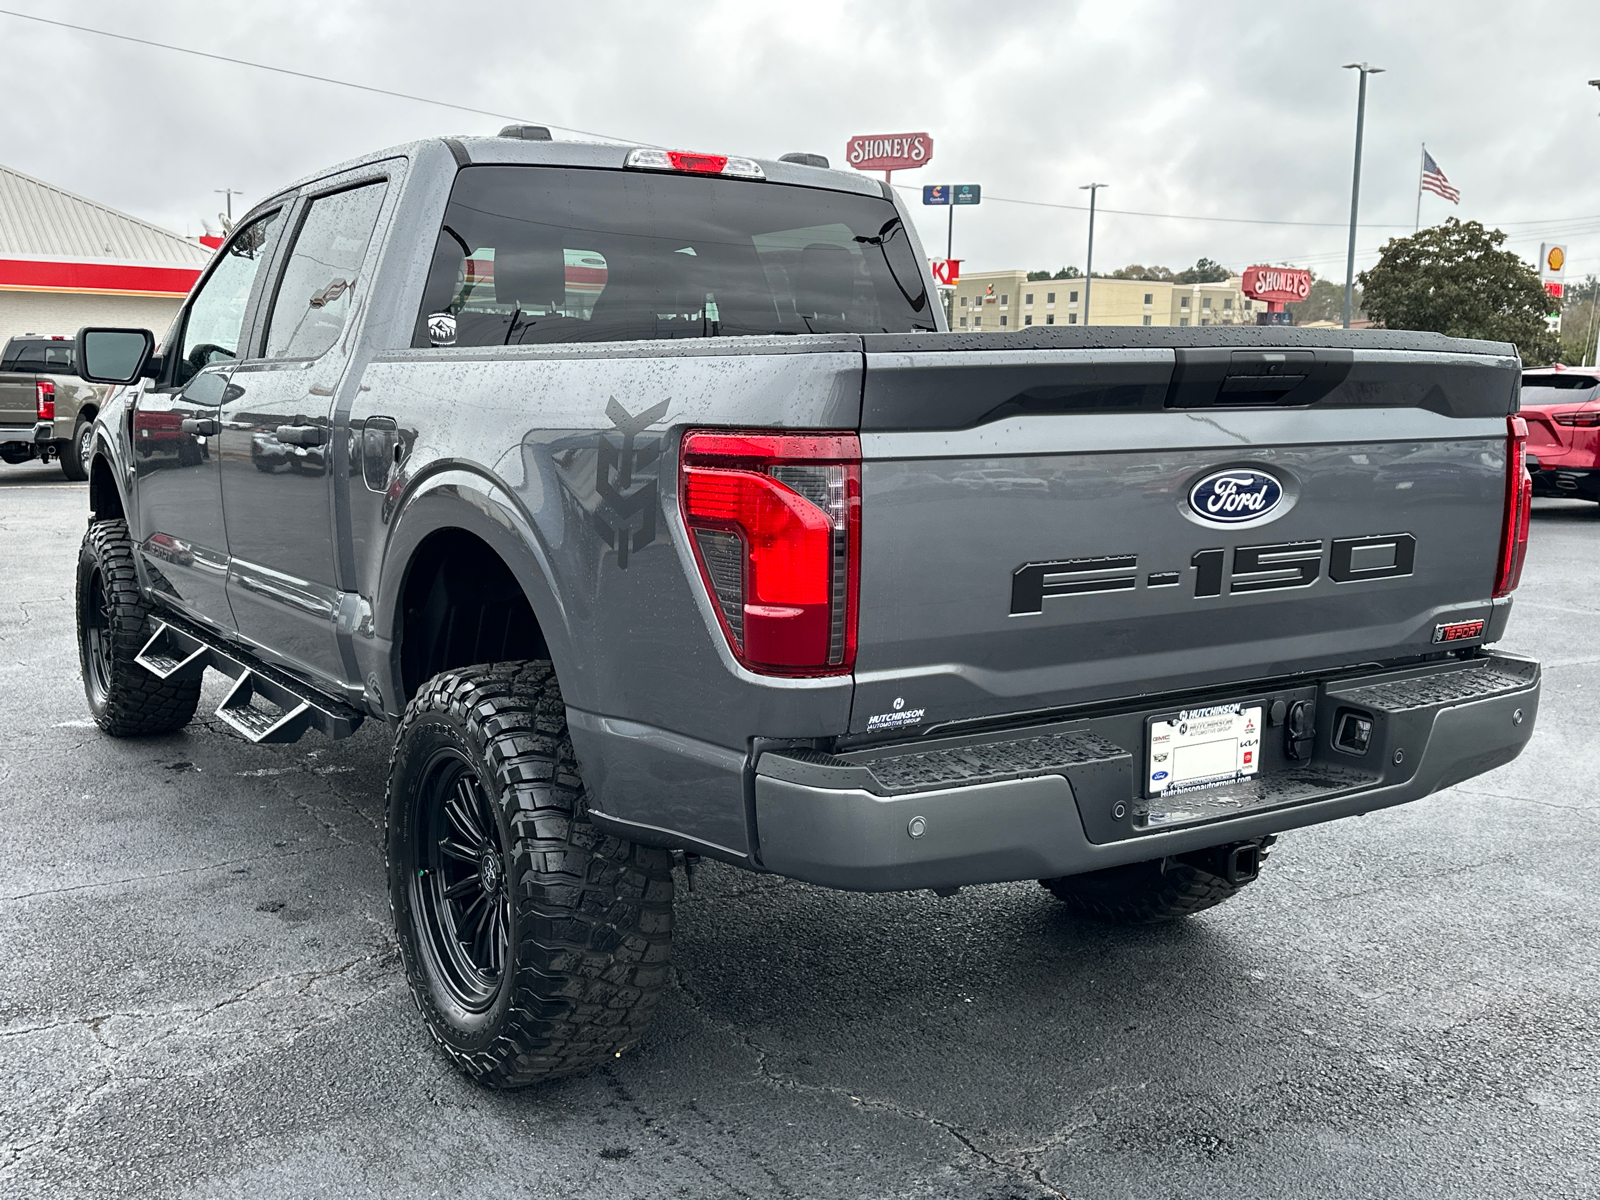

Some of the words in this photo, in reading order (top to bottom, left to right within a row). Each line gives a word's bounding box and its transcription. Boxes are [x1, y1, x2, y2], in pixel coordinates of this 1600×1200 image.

[850, 135, 925, 163] SHONEY'S
[932, 262, 949, 285] K
[1255, 271, 1310, 298] SHONEY'S
[1206, 477, 1266, 512] Ford
[1008, 532, 1417, 617] F-150
[868, 708, 925, 724] HUTCHINSON
[1189, 703, 1240, 719] HUTCHINSON
[868, 719, 902, 729] AUTOMOTIVE
